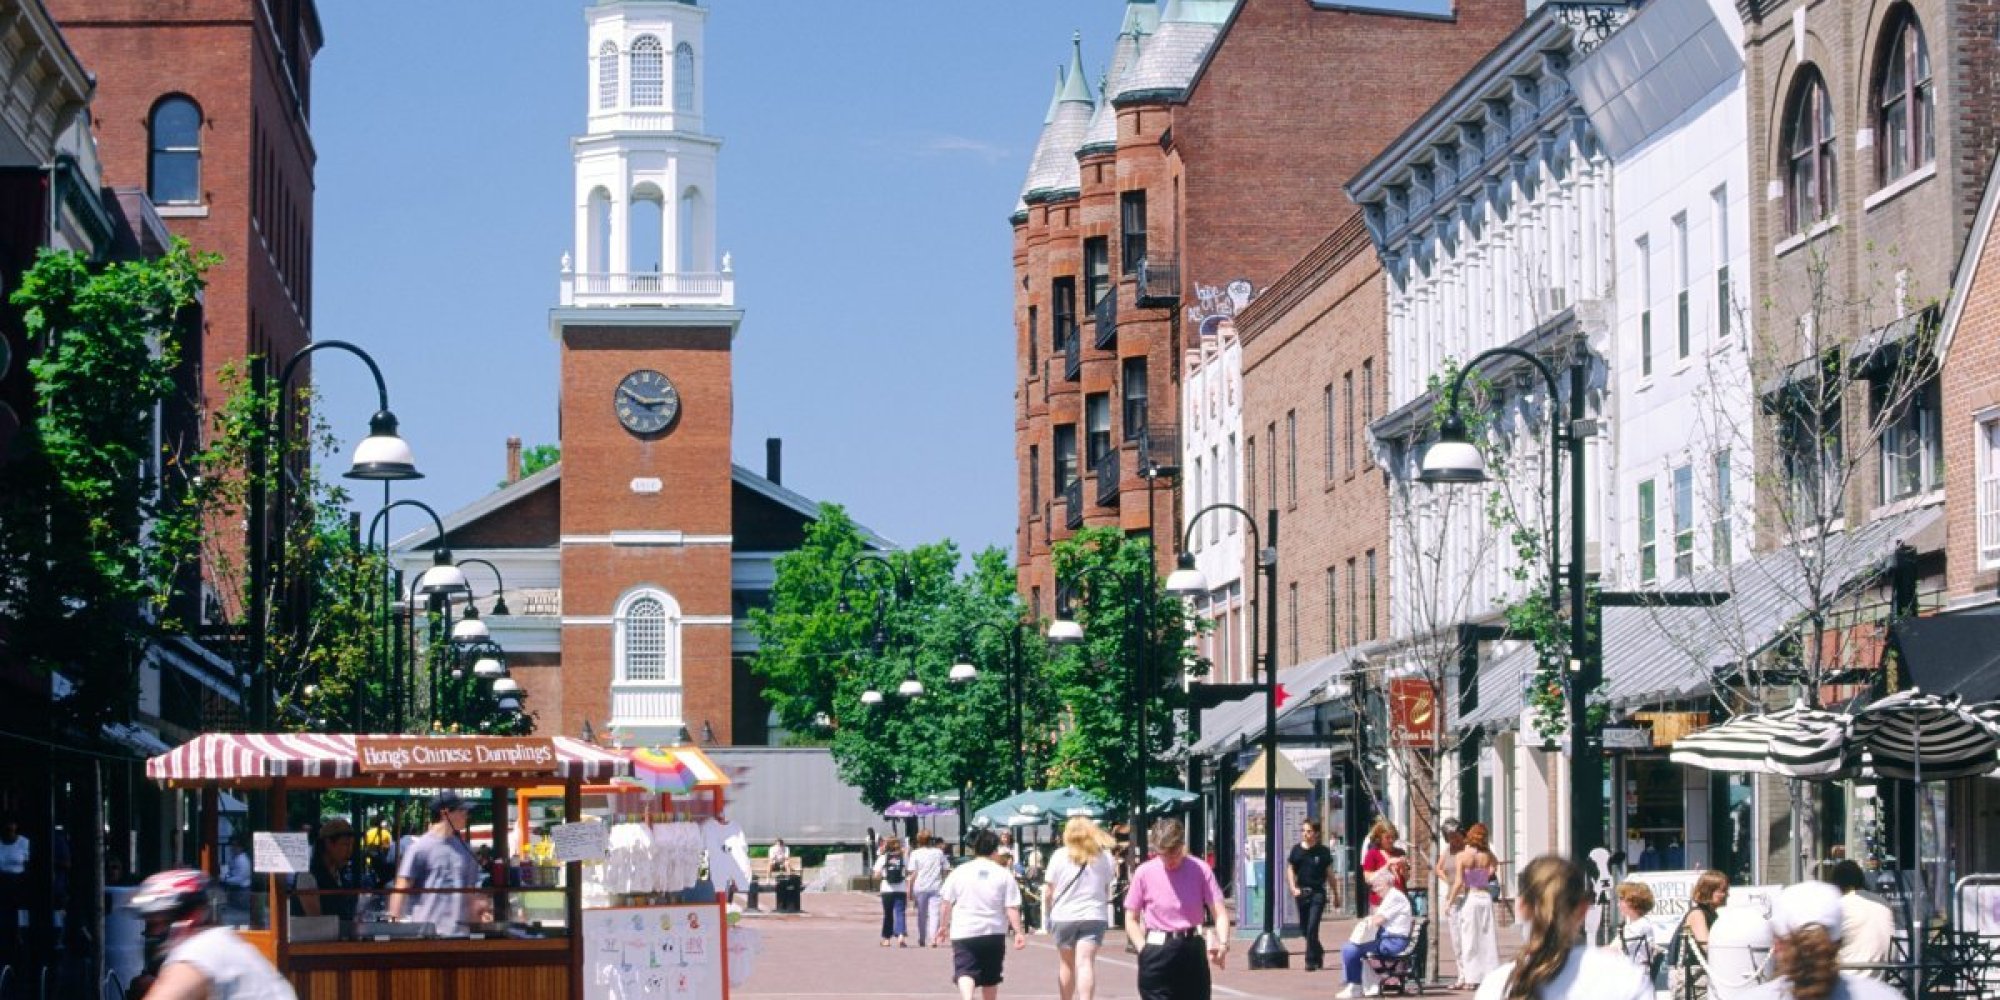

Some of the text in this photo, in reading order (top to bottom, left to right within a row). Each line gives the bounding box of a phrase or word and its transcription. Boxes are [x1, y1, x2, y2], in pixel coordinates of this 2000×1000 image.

[363, 743, 552, 769] Hong's Chinese Dumplings
